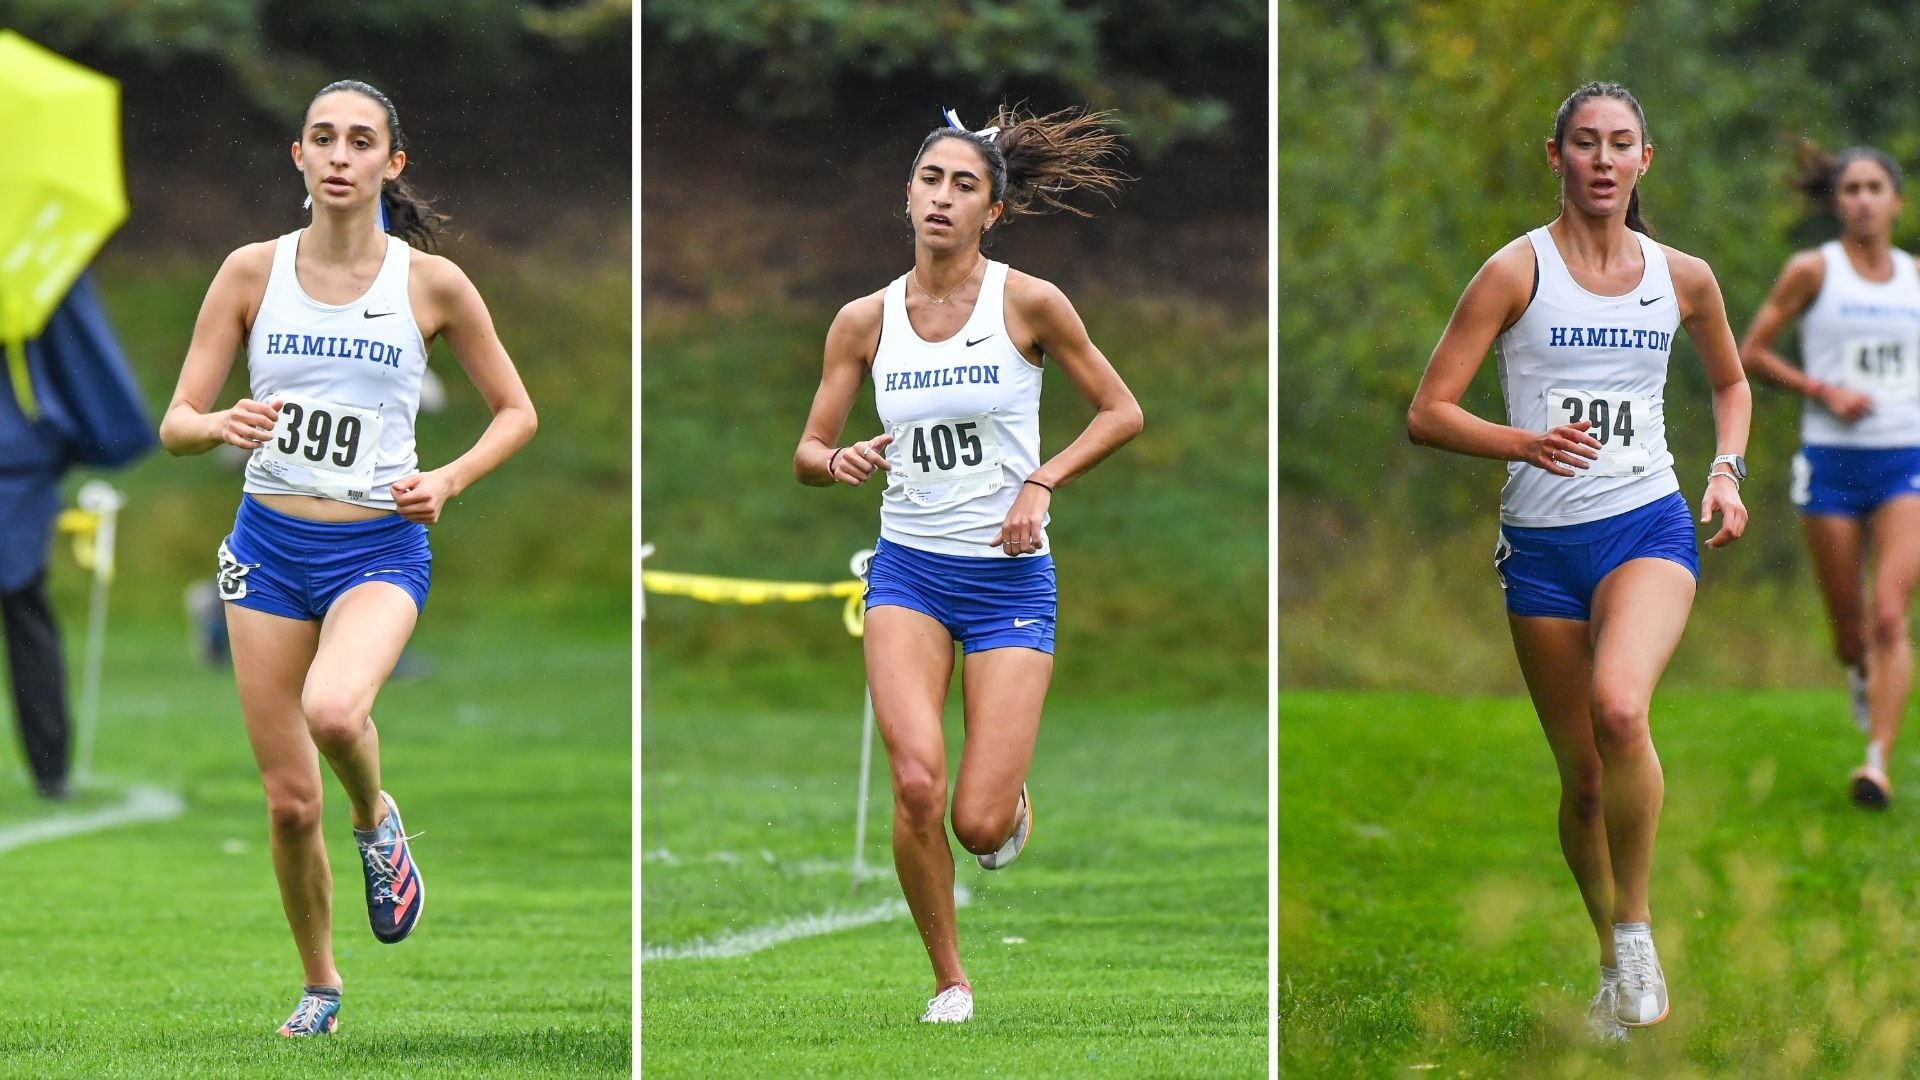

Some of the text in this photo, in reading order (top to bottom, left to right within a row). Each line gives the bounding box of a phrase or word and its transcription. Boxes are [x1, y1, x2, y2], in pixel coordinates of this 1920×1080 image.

[266, 334, 403, 368] HAMILTON
[1550, 327, 1670, 352] HAMILTON
[885, 365, 1000, 392] HAMILTON
[277, 402, 362, 468] 399
[1562, 397, 1635, 447] 394
[912, 421, 983, 473] 405
